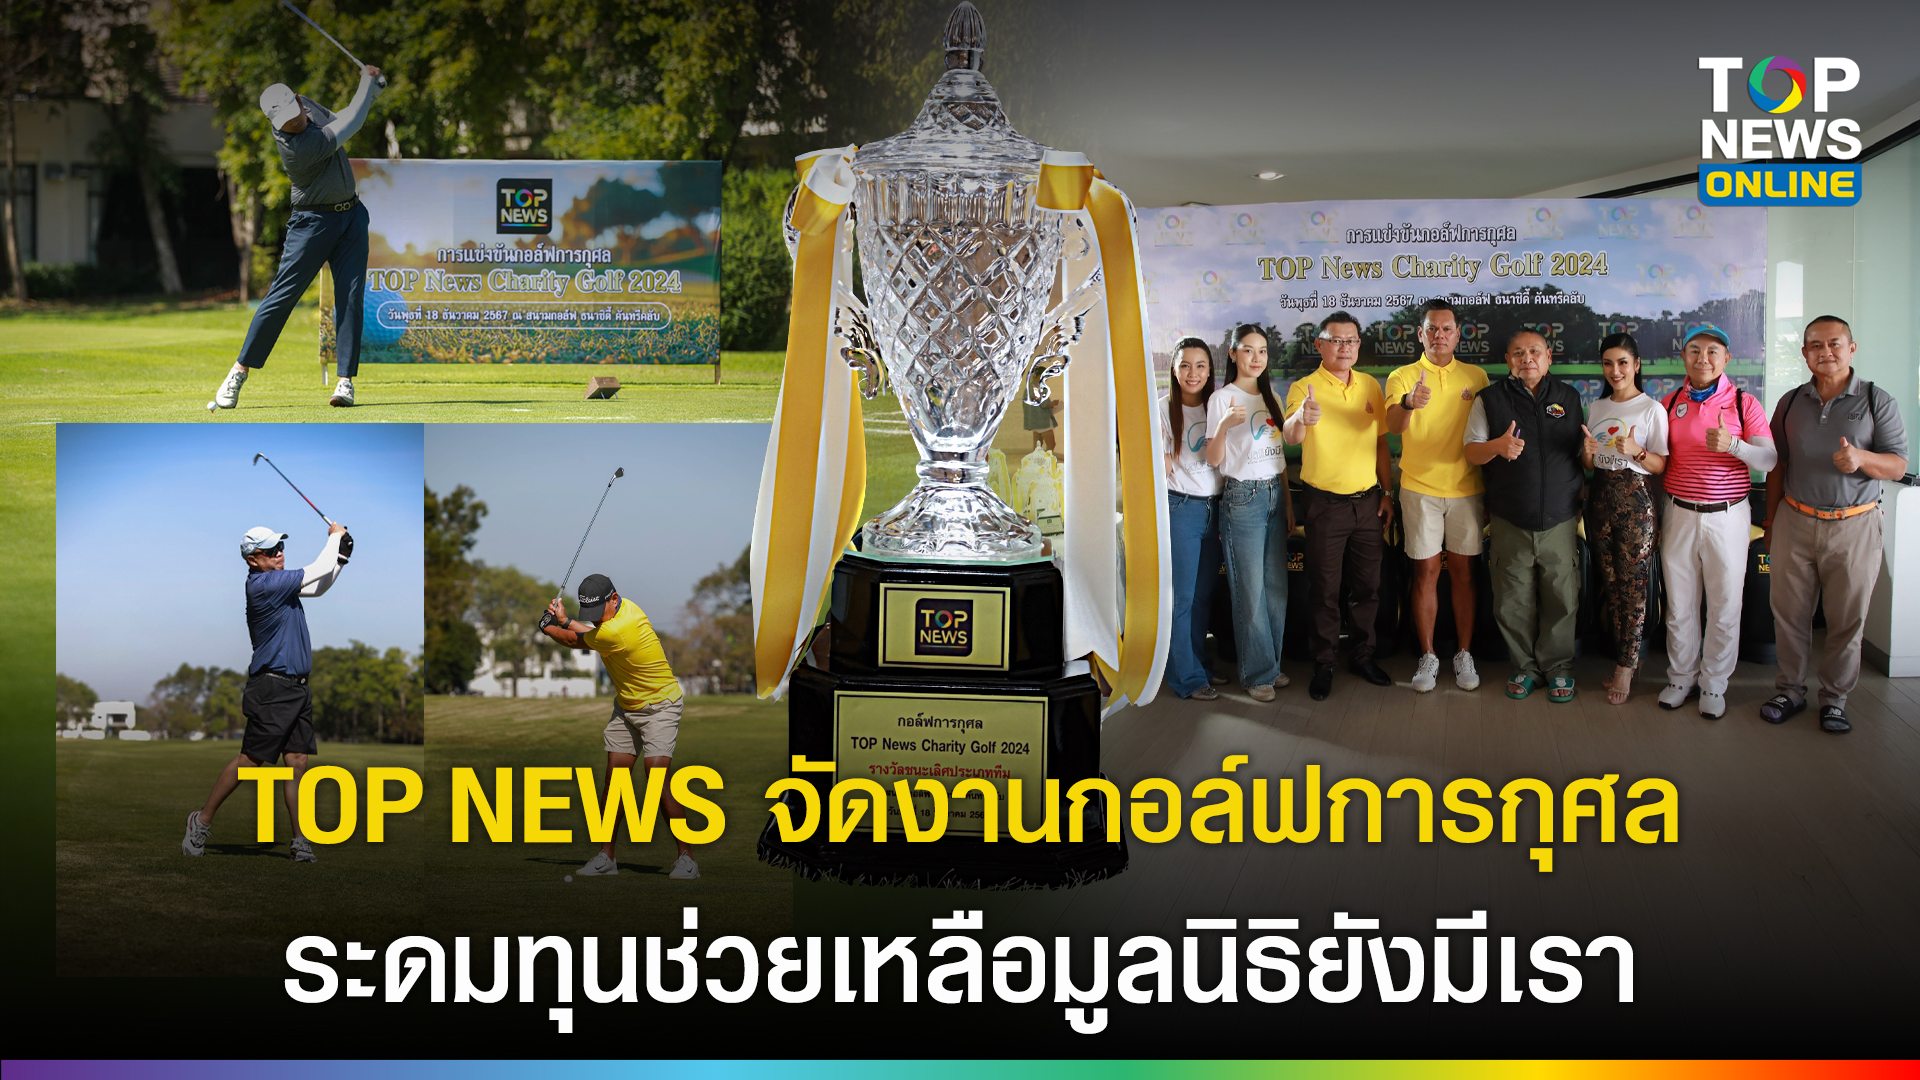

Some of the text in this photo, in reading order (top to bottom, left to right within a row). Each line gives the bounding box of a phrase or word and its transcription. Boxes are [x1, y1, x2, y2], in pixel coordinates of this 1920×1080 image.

[500, 188, 548, 207] TOP
[500, 208, 548, 223] NEWS
[1346, 221, 1517, 247] การแข่งขันกอล์ฟการกุศล
[437, 242, 612, 269] การแข่งขันกอล์ฟการกุศล
[1257, 250, 1610, 285] TOP News Charity Golf 2024
[367, 268, 682, 298] TOP News Charity Golf 2024
[1281, 290, 1319, 312] วันพุธที่
[1322, 295, 1337, 308] 18
[1340, 293, 1382, 308] ธันวาคม
[1385, 294, 1414, 308] 2567
[387, 305, 422, 324] วันพุธที่
[426, 310, 439, 321] 18
[442, 308, 480, 321] ธันวาคม
[483, 310, 509, 321] 2567
[512, 311, 523, 321] ณ
[526, 308, 577, 321] สนามกอล์ฟ
[1375, 324, 1415, 340] TOP
[1460, 323, 1490, 340] OP
[1374, 341, 1415, 354] NEWS
[1642, 379, 1675, 395] OP
[1287, 553, 1304, 562] OP
[920, 609, 968, 629] TOP
[920, 629, 968, 645] NEWS
[897, 712, 983, 734] กอล์ฟการกุศล
[851, 736, 1031, 755] TOP News Charity Golf 2024
[868, 761, 1011, 780] รางวัลชนะเลิศประเภททีม
[920, 809, 931, 817] 18
[970, 811, 985, 819] 256
